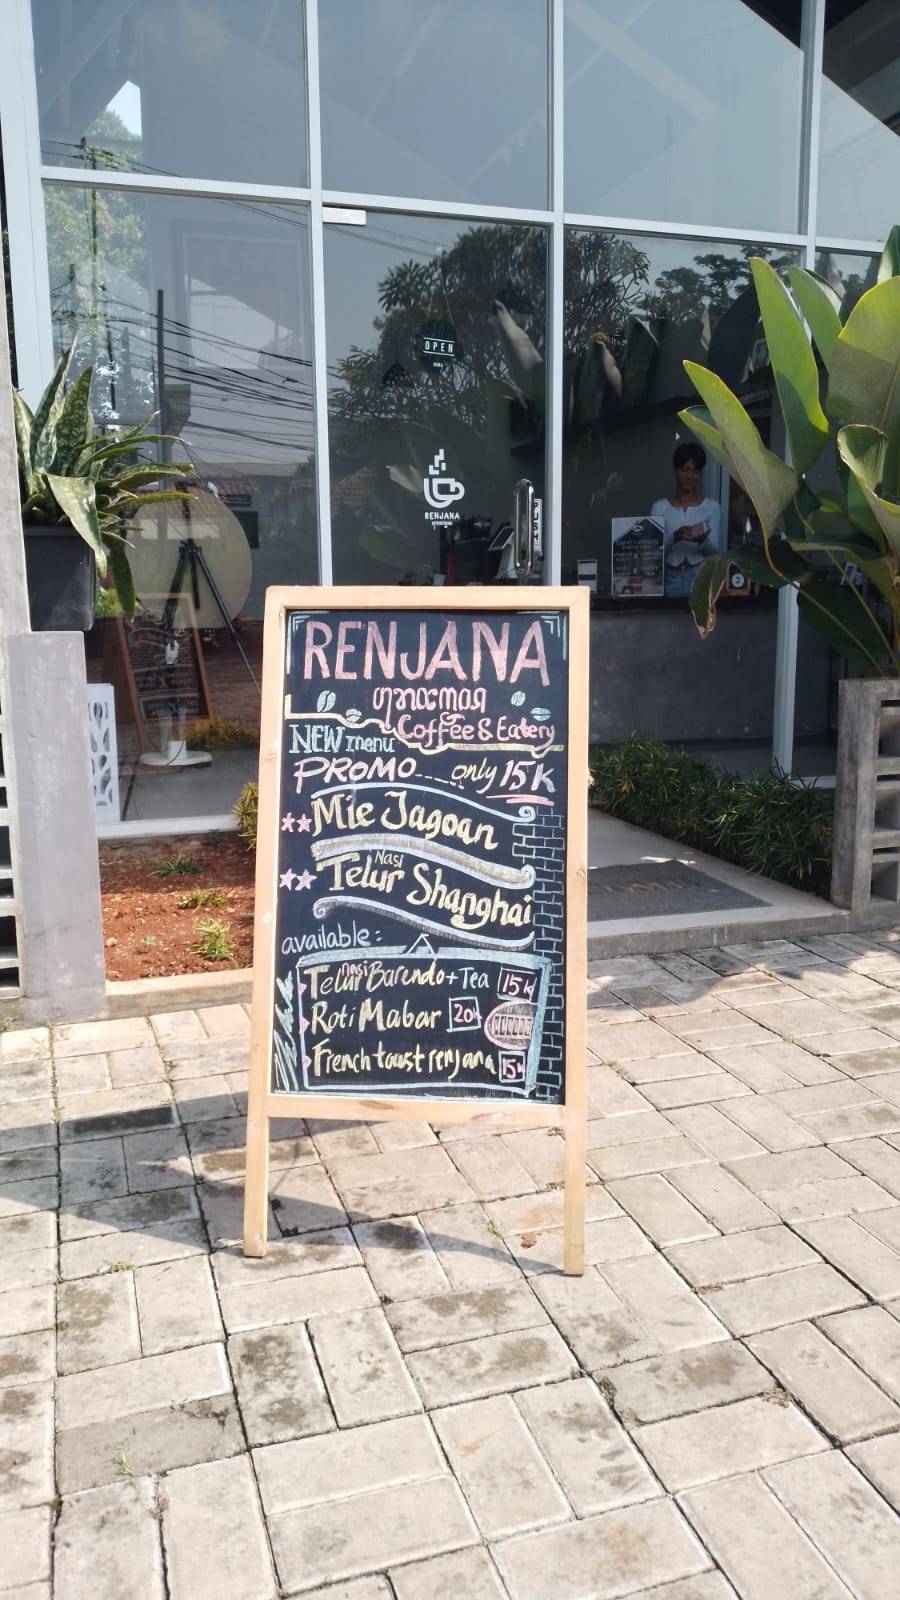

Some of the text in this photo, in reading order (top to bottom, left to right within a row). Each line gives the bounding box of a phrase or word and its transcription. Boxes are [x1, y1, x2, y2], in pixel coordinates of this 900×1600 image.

[424, 340, 454, 353] OPEN
[424, 511, 460, 520] RENJANA
[735, 576, 741, 584] 2
[303, 620, 550, 687] RENJANA
[288, 724, 397, 754] NEW menu
[397, 713, 555, 749] Coffee & Eatery
[451, 757, 498, 795] only
[311, 790, 498, 850] Mie Jagoan
[374, 850, 404, 868] Nasi
[315, 852, 534, 930] Telur Shanghai
[303, 964, 363, 1000] Telur
[341, 960, 368, 977] nasi
[311, 1000, 355, 1035] Roti
[358, 997, 442, 1033] Mabar
[312, 1038, 371, 1077] French
